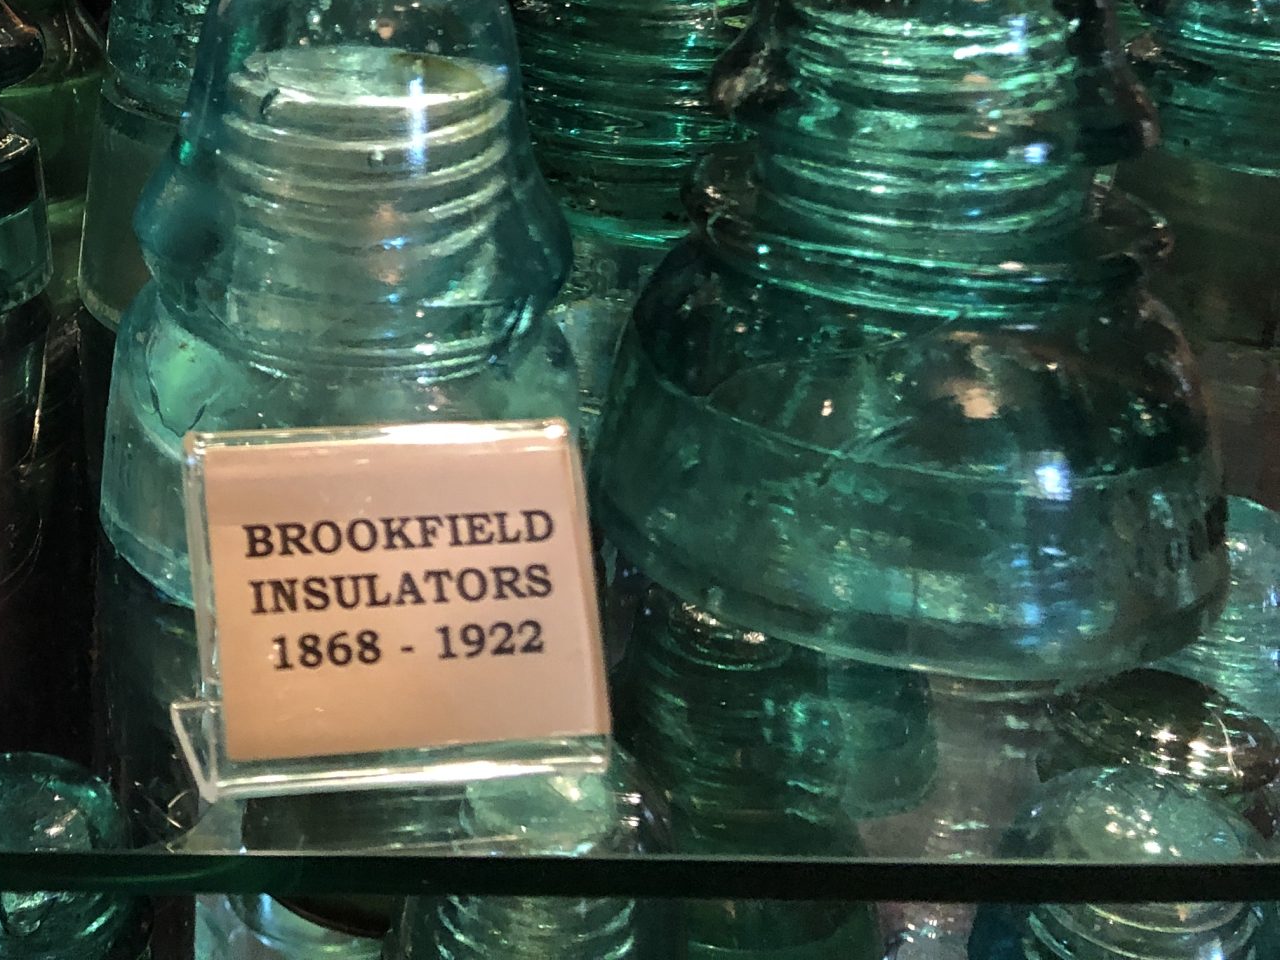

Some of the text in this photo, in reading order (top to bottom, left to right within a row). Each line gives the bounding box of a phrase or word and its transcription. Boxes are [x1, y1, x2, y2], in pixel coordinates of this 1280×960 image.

[241, 508, 555, 559] BROOKFIELD
[248, 563, 553, 615] INSULATORS
[271, 619, 546, 671] 1868 - 1922
